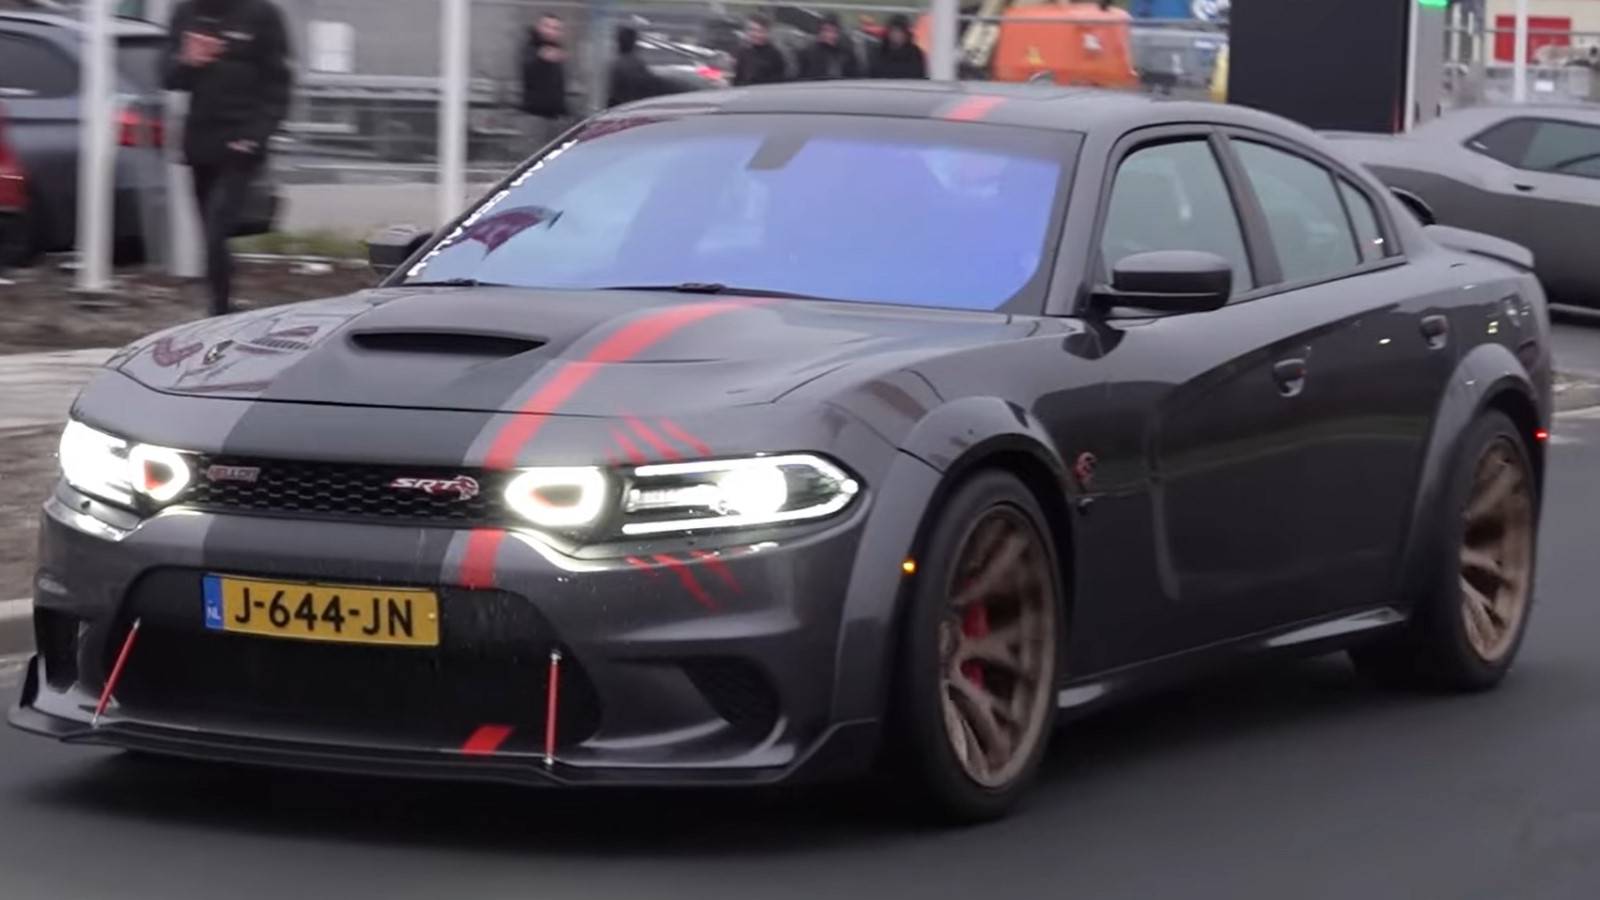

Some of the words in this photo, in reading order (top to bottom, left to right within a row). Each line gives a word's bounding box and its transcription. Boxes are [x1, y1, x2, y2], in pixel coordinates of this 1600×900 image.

[391, 478, 461, 494] SRT
[207, 606, 222, 620] NL
[234, 587, 415, 638] J-644-JN
